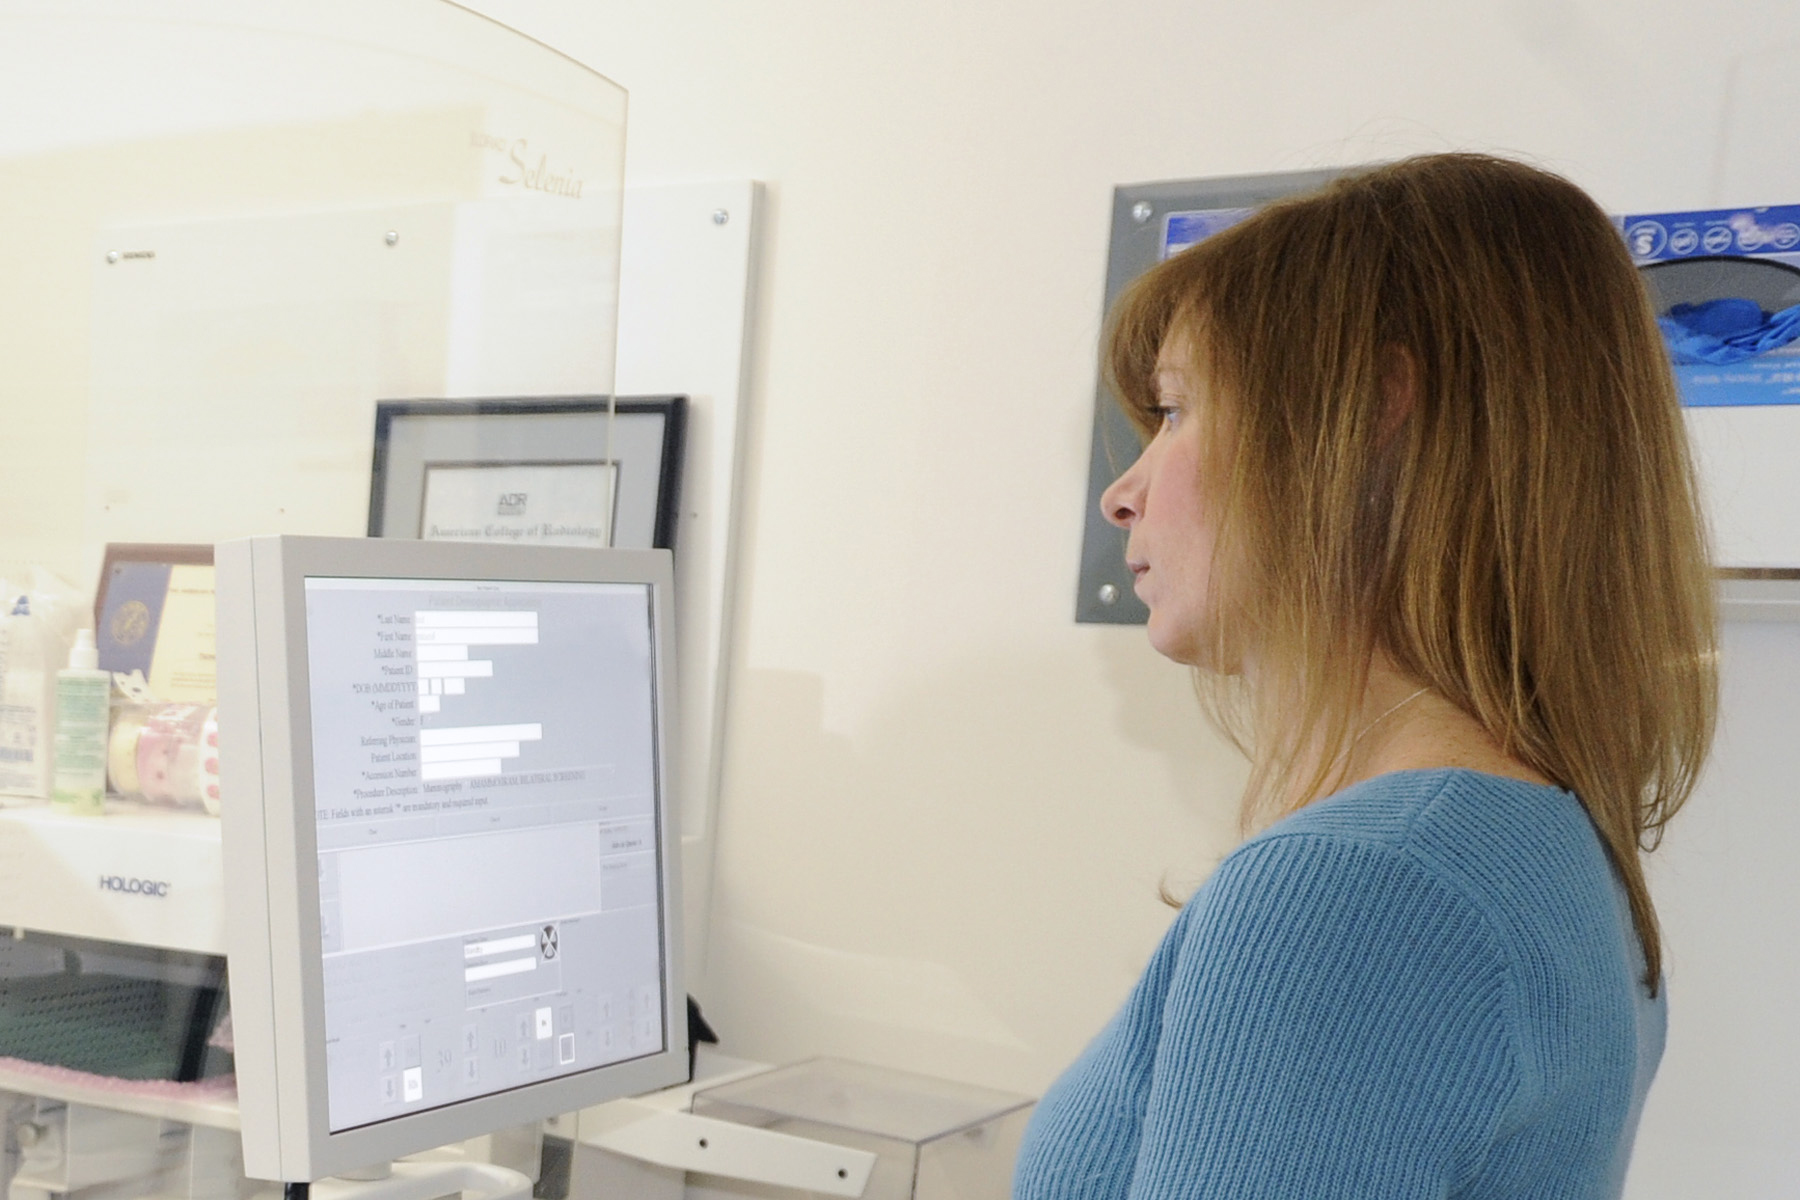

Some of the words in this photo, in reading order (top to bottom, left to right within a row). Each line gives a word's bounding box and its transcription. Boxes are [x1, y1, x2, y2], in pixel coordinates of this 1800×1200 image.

[498, 138, 583, 200] Selenia
[431, 525, 481, 538] American
[485, 524, 523, 540] College
[527, 524, 538, 537] of
[542, 523, 602, 540] Radiology
[99, 875, 168, 897] HOLOGIC
